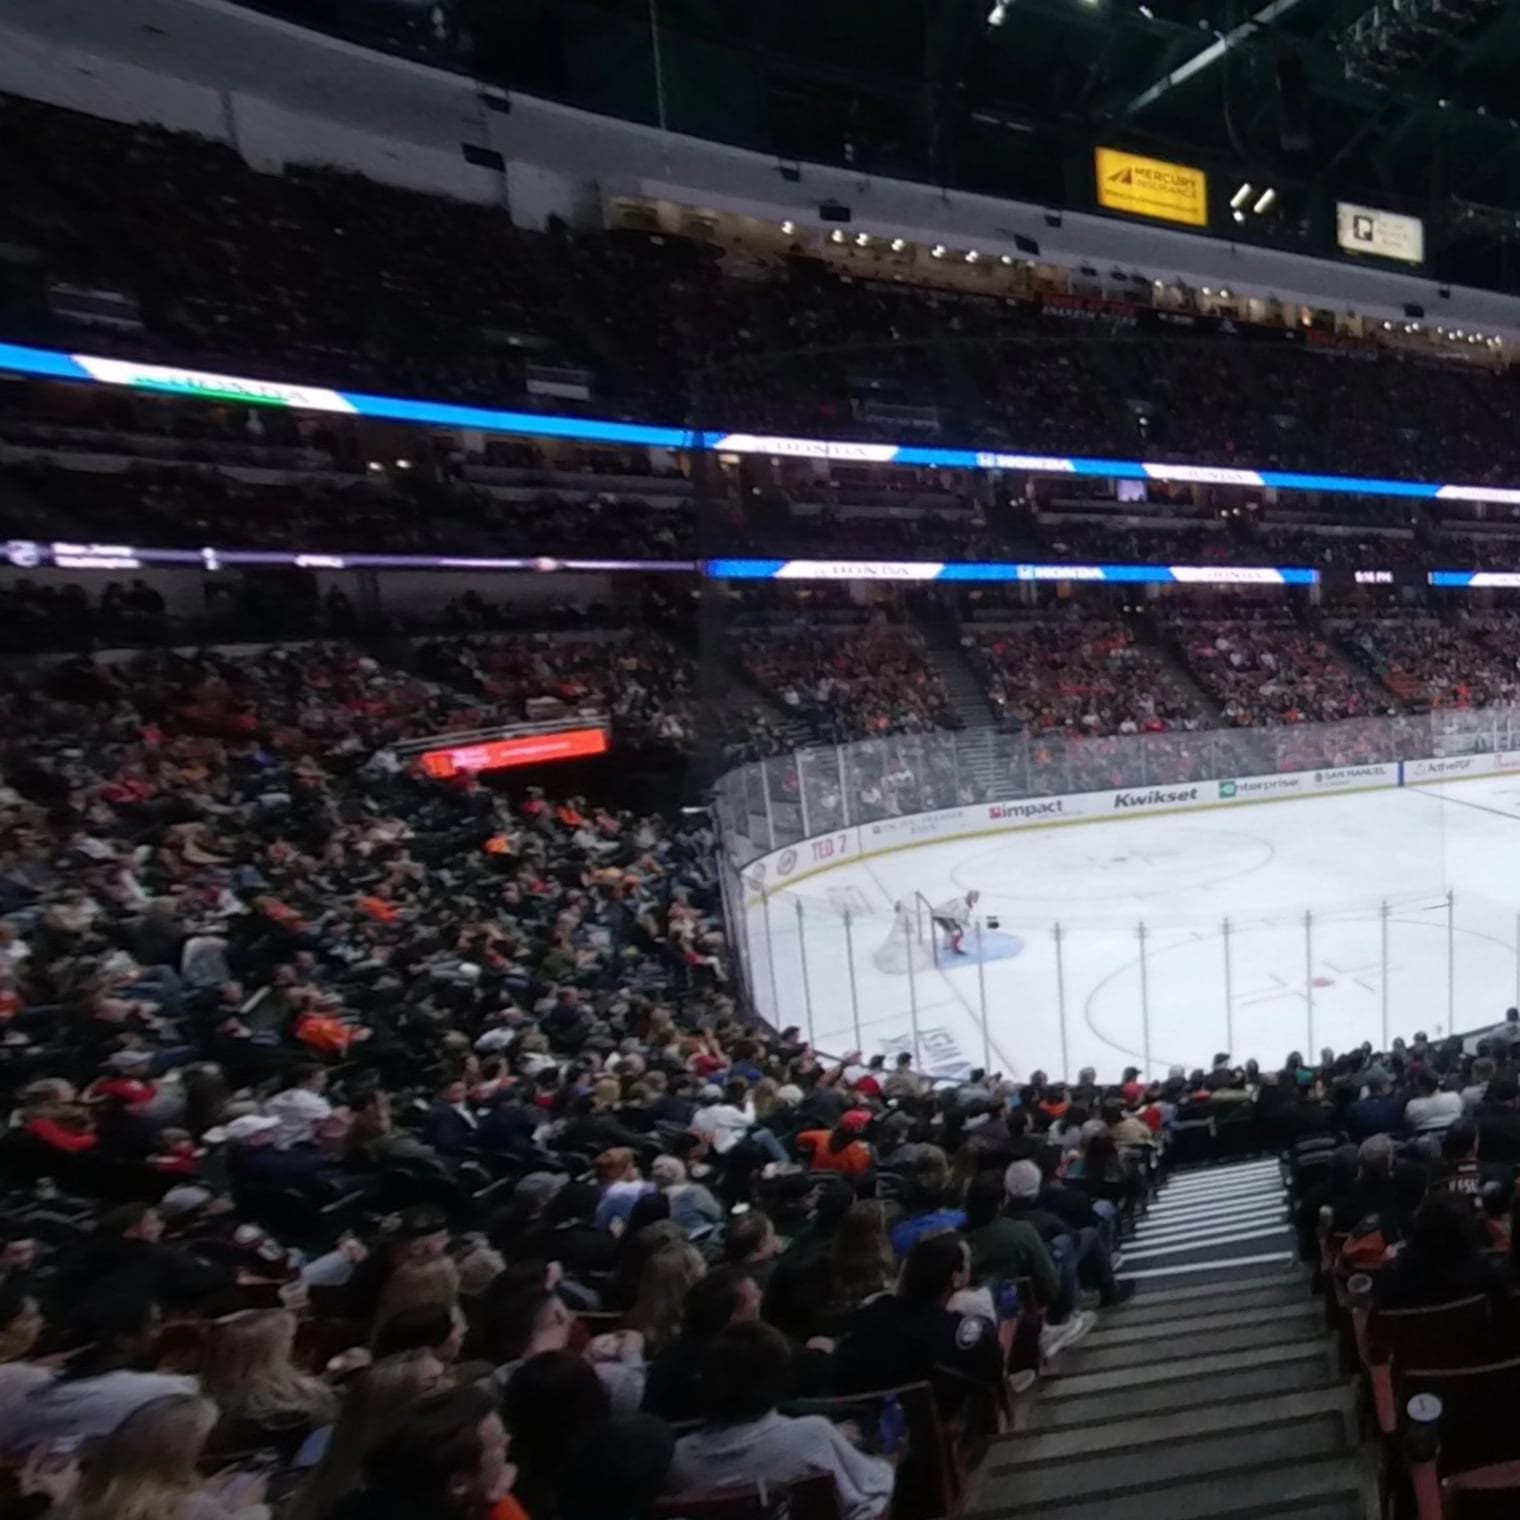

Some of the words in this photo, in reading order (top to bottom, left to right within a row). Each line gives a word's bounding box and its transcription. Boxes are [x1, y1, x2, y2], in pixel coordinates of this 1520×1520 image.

[1134, 168, 1197, 188] MERCURY
[776, 441, 867, 456] HONDA
[831, 566, 910, 577] HONDA
[1324, 770, 1343, 780] SAN
[1346, 766, 1386, 777] MANUEL
[1113, 787, 1198, 809] Kwikset
[1002, 799, 1063, 819] impact
[838, 834, 848, 853] 7
